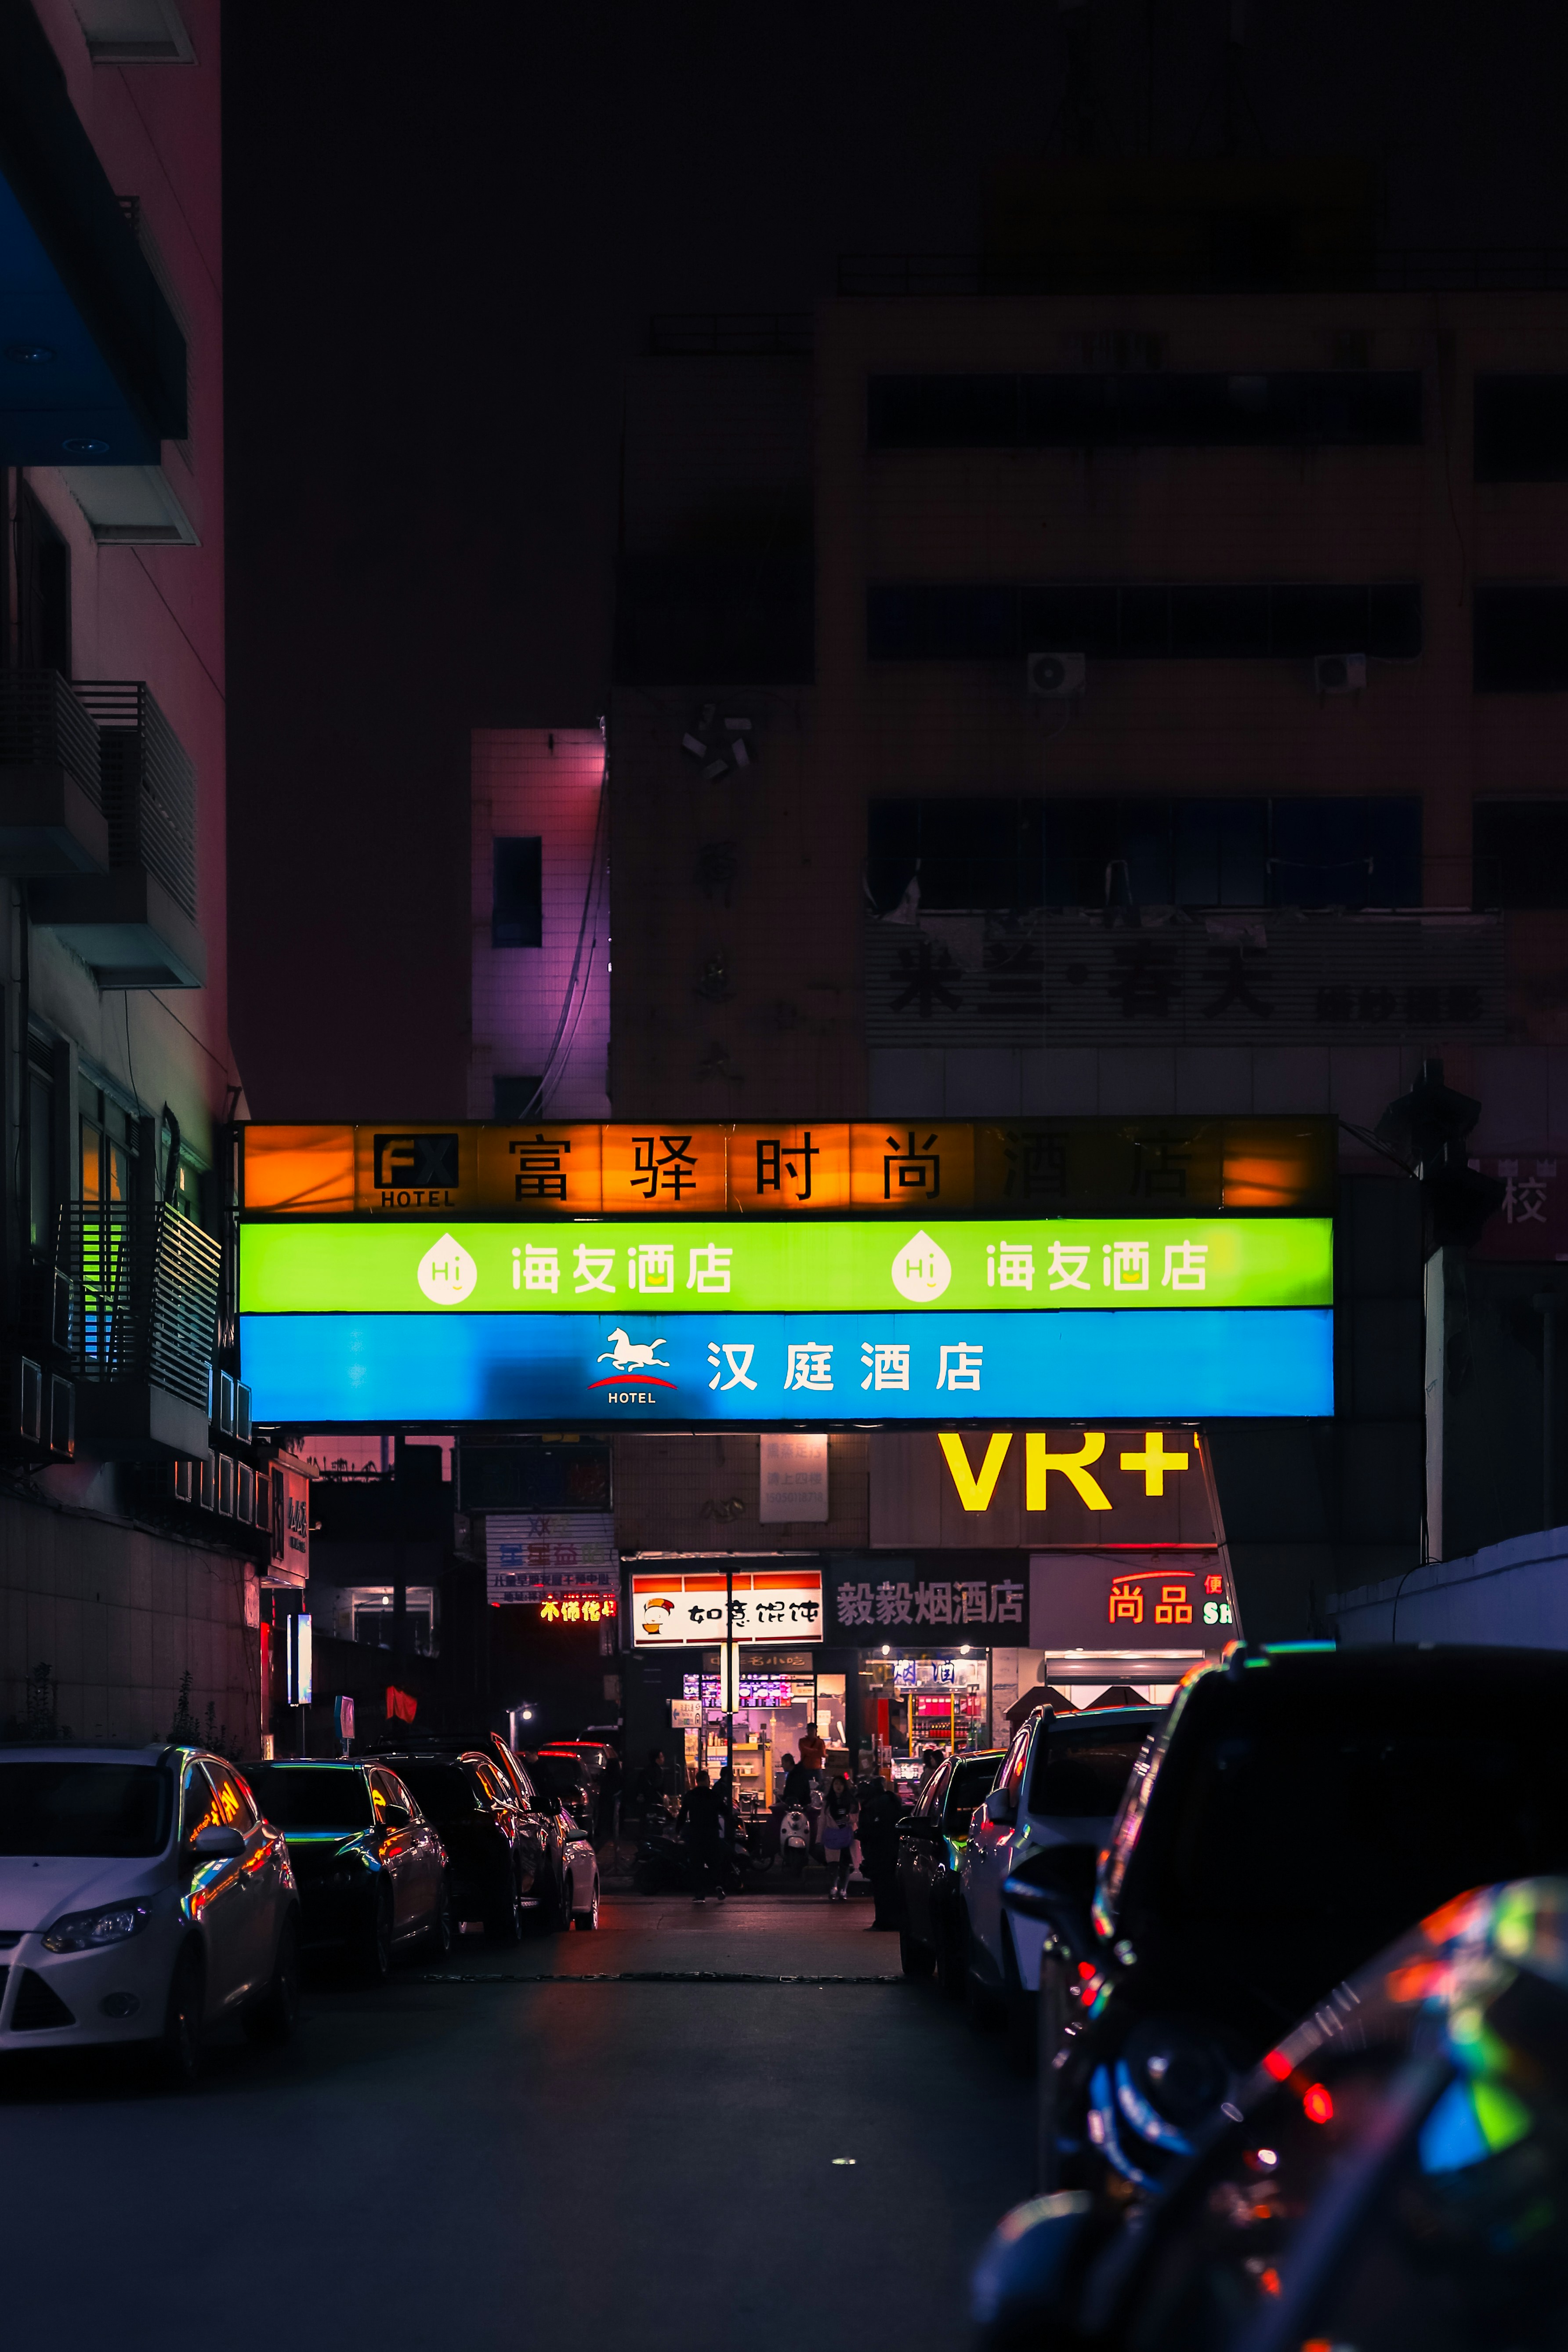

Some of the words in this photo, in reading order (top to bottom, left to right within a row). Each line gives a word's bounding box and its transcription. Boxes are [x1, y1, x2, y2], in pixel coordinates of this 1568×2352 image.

[381, 1134, 455, 1185] FX
[509, 1131, 1192, 1201] 富驿时尚酒店
[382, 1191, 454, 1207] HOTEL
[1502, 1177, 1547, 1224] 校
[432, 1256, 460, 1281] Hi
[512, 1243, 732, 1294] 海友酒店
[906, 1253, 934, 1278] Hi
[987, 1240, 1208, 1291] 海友酒店
[707, 1342, 984, 1391] 汉庭酒店
[608, 1392, 656, 1404] HOTEL
[837, 1579, 1024, 1625] 毅毅烟酒店
[1109, 1584, 1192, 1624] 尚品
